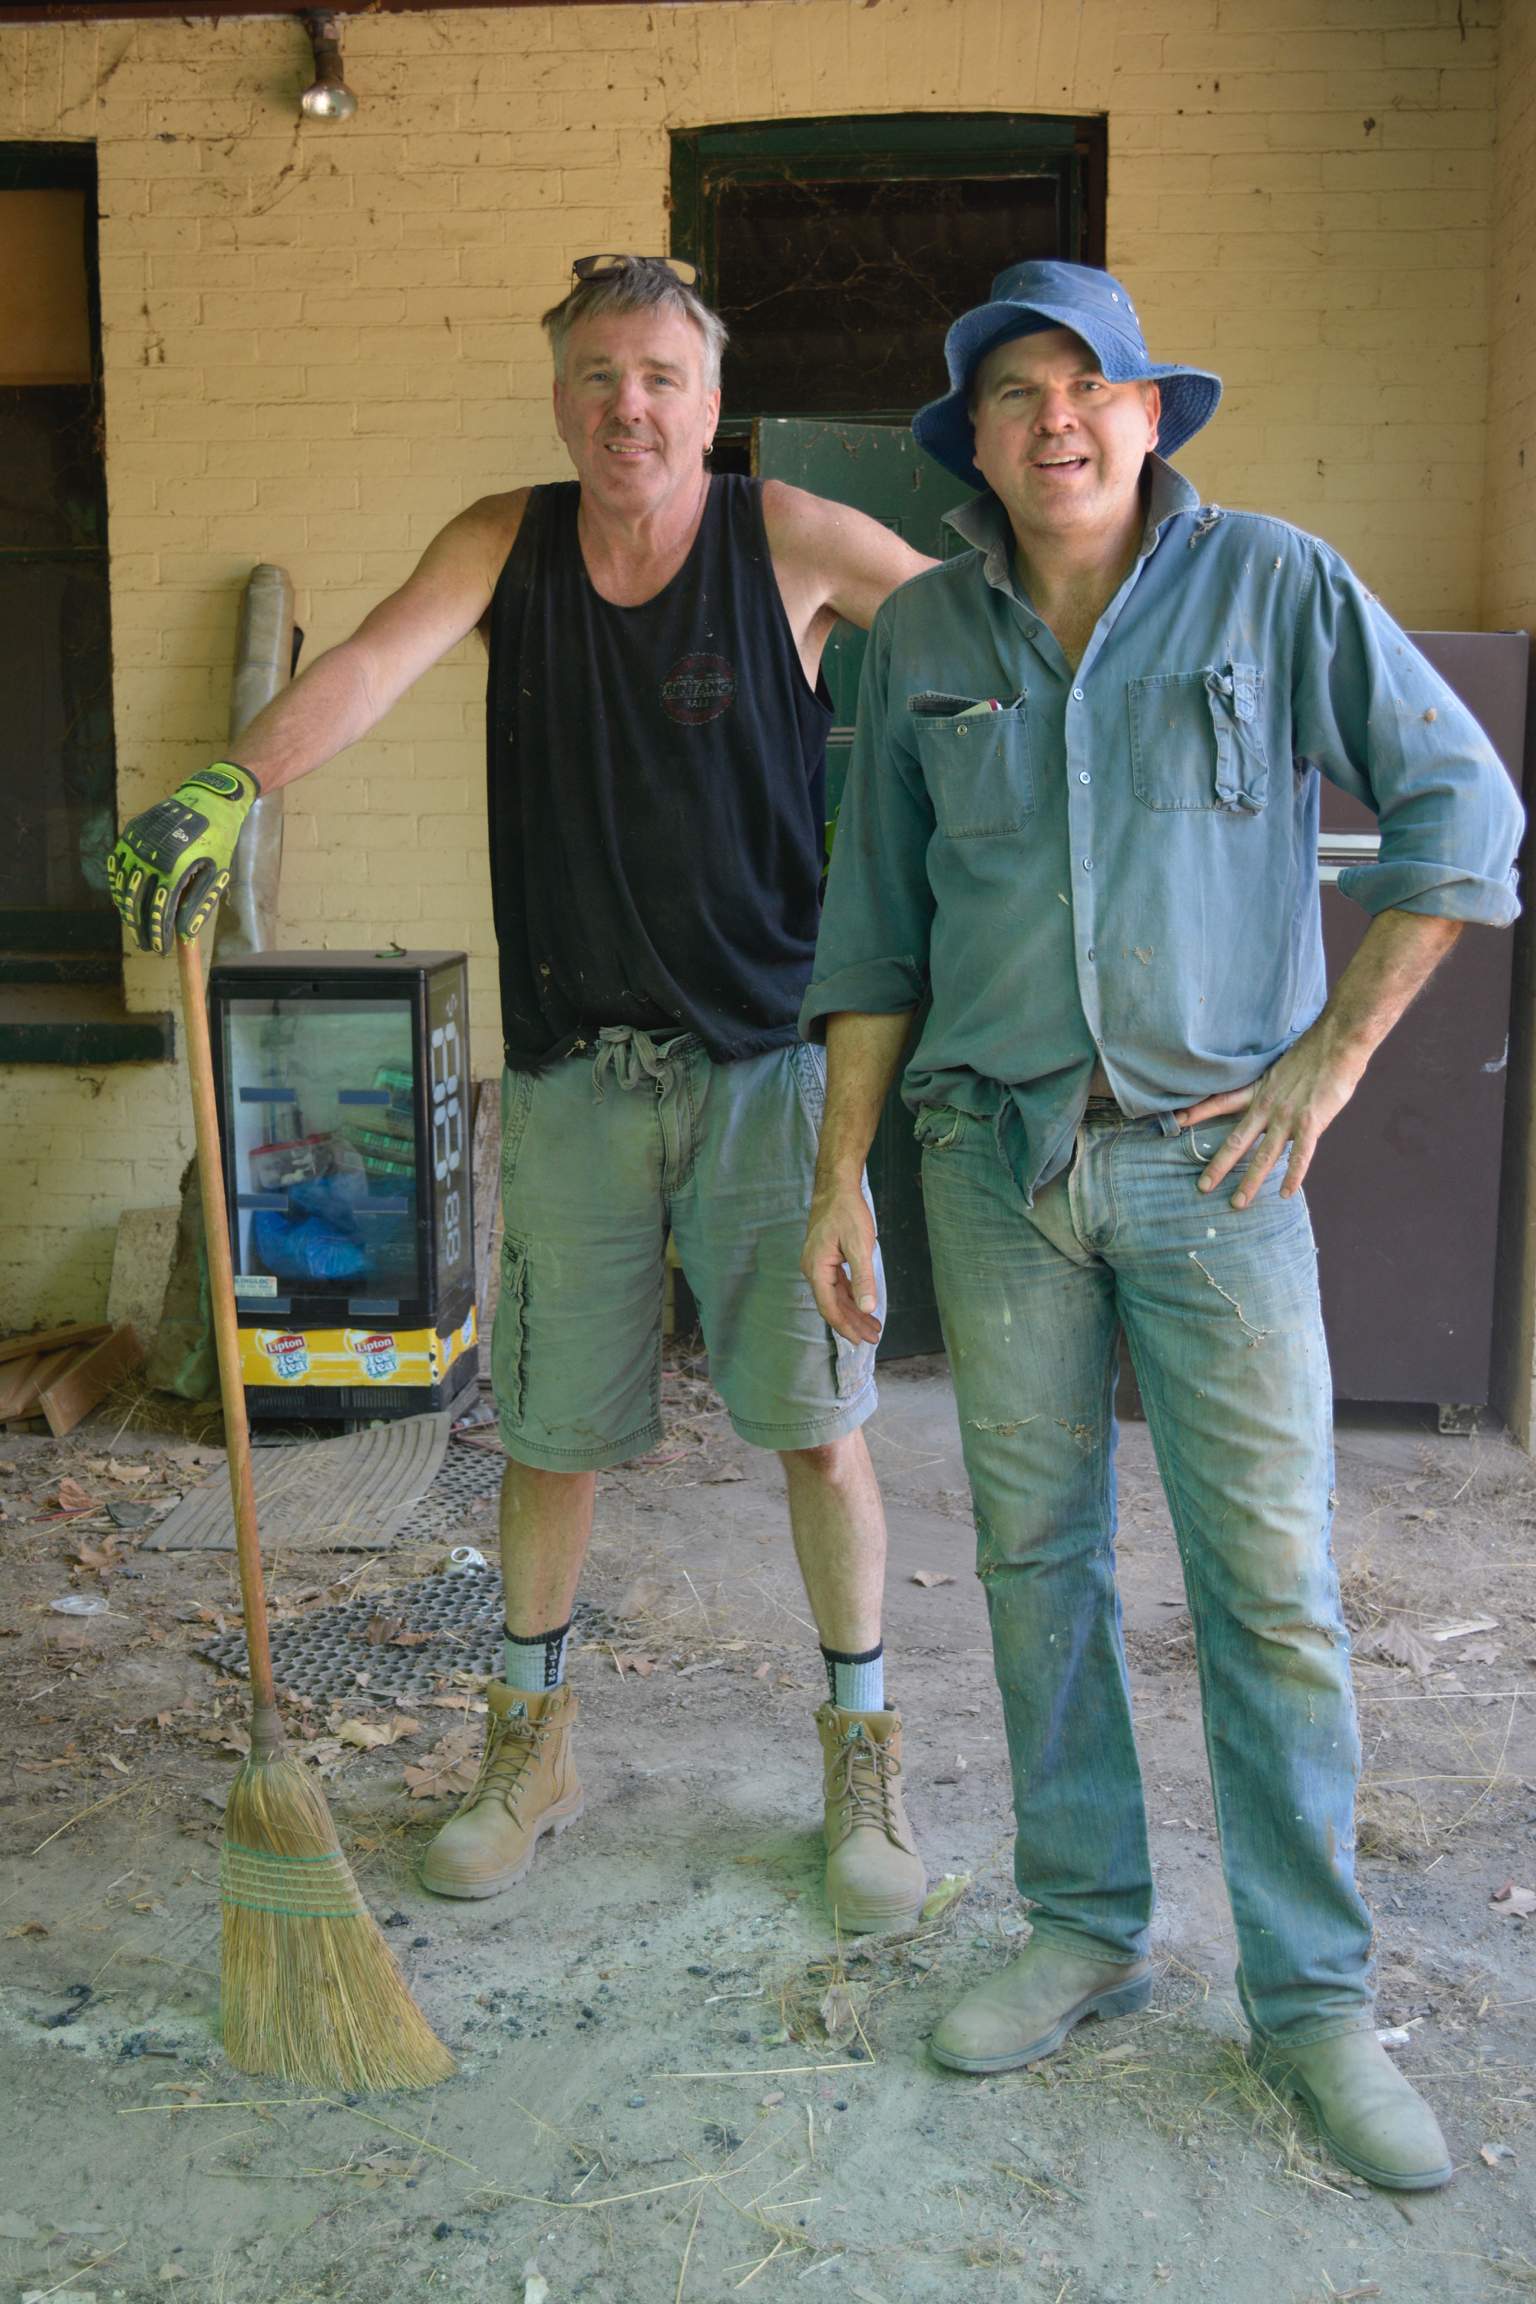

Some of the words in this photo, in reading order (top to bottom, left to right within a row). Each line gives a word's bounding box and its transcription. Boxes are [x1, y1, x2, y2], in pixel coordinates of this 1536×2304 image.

[268, 1338, 302, 1353] Lipton
[357, 1338, 391, 1353] Lipton
[278, 1352, 304, 1364] Ice
[367, 1352, 392, 1365] Ice
[278, 1360, 307, 1375] Tea
[367, 1360, 396, 1375] Tea
